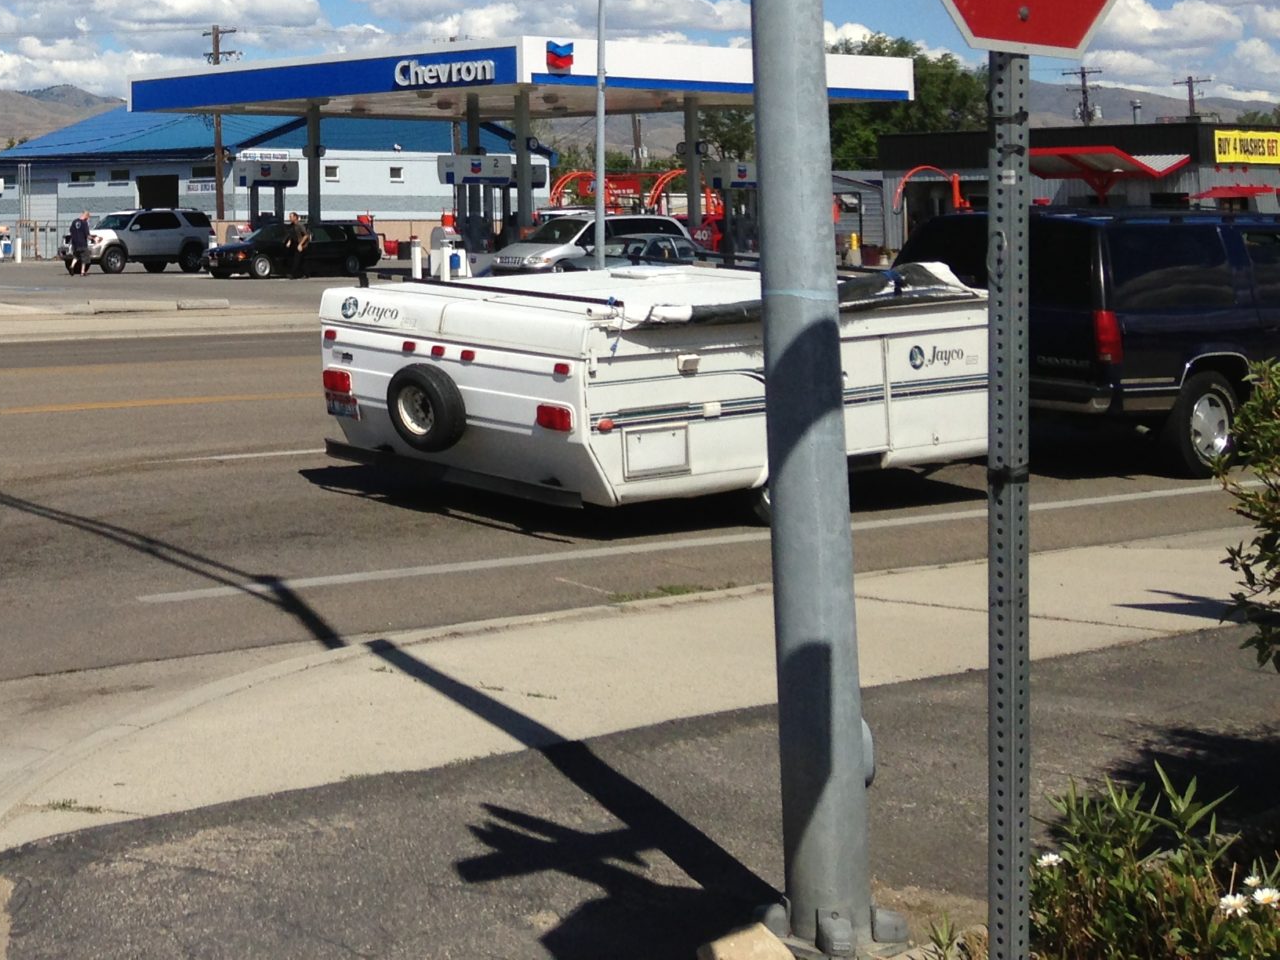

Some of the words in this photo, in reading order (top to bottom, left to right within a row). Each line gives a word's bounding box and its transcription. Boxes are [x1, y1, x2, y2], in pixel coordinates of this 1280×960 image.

[394, 59, 495, 86] Chevron
[1217, 137, 1231, 155] BUY
[1239, 137, 1266, 156] WASHES
[1267, 139, 1279, 157] GET
[358, 301, 399, 322] Jayco
[927, 345, 964, 366] Jayco
